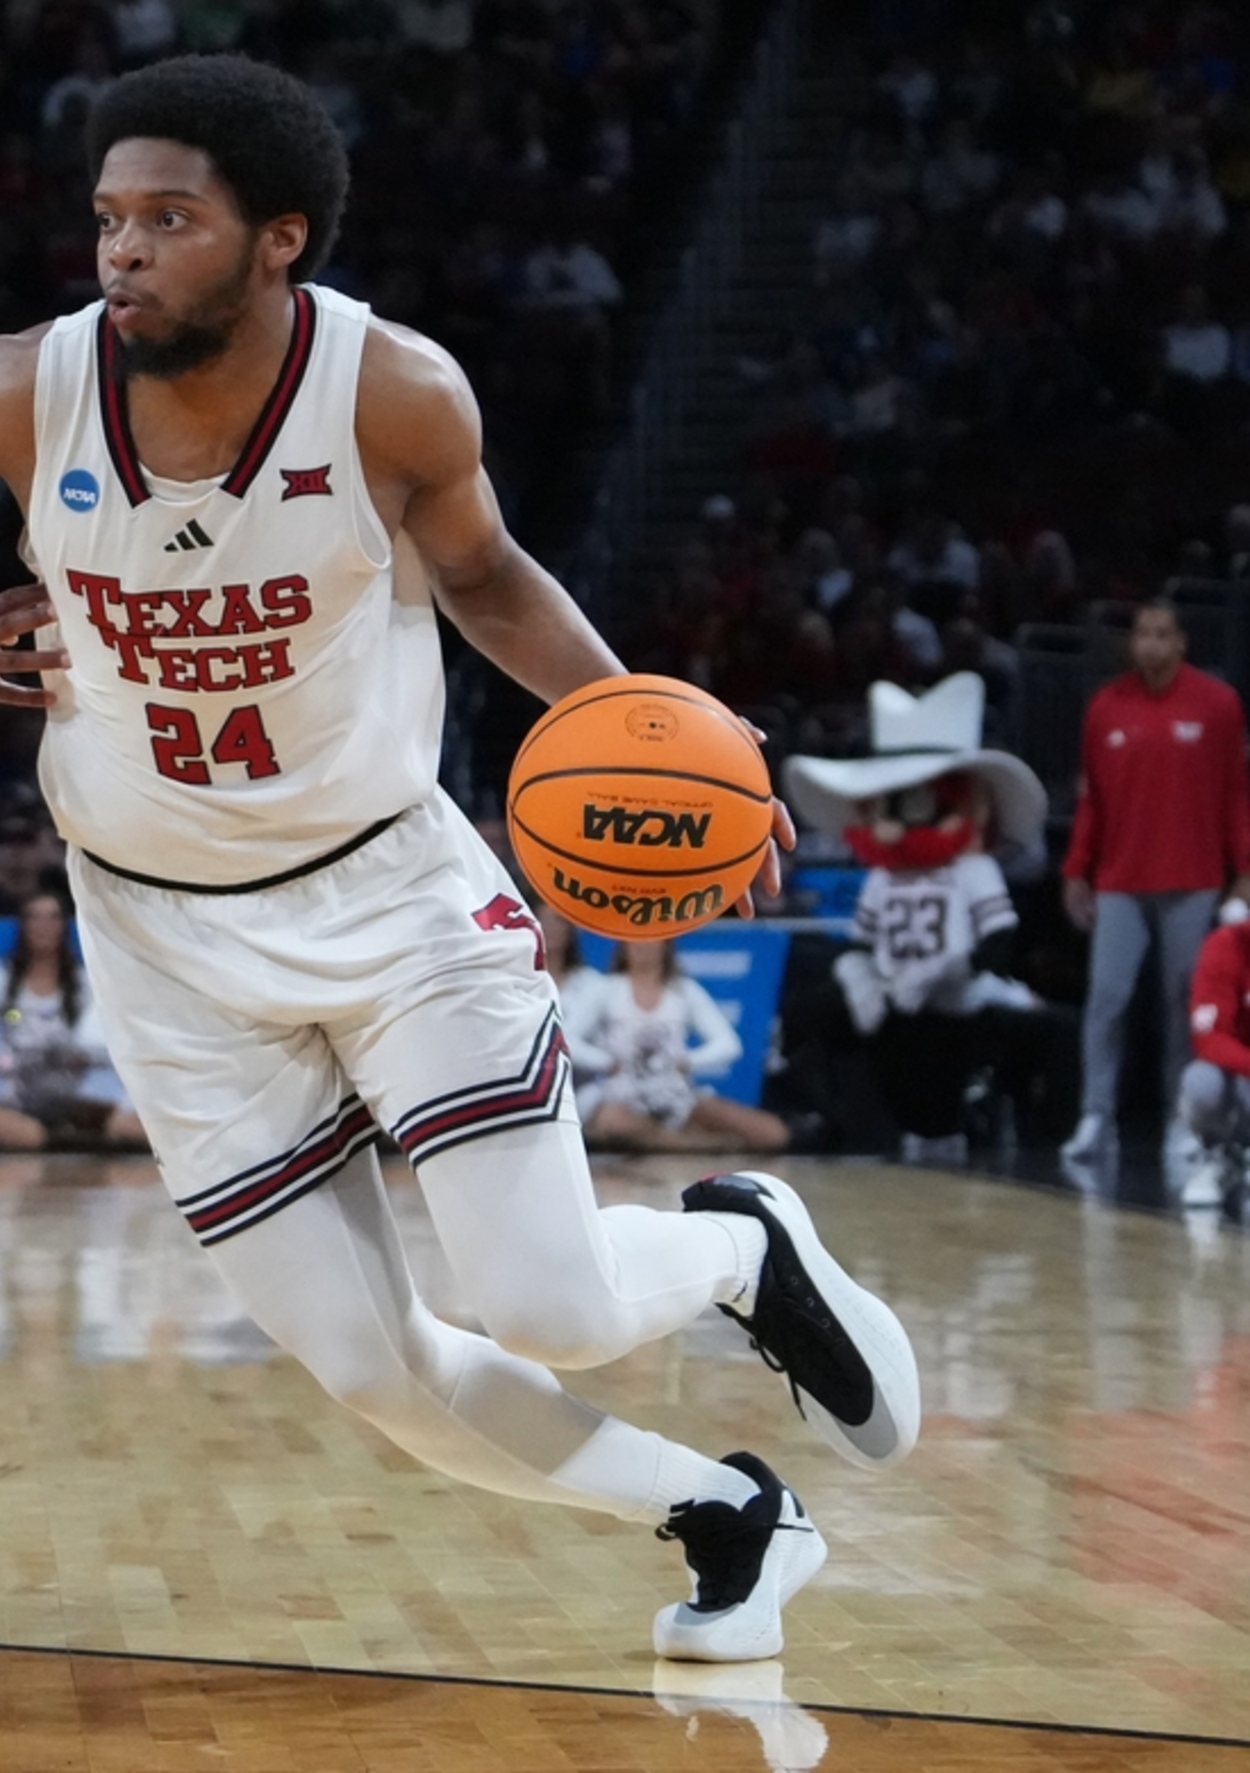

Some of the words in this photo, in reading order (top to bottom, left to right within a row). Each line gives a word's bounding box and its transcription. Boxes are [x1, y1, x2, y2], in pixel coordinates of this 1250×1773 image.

[63, 488, 97, 504] NCAA
[66, 568, 312, 637] TEXAS
[98, 627, 296, 692] TECH
[145, 702, 281, 785] 24
[583, 804, 712, 849] NCAA
[552, 867, 723, 925] Wilson
[884, 895, 947, 959] 23
